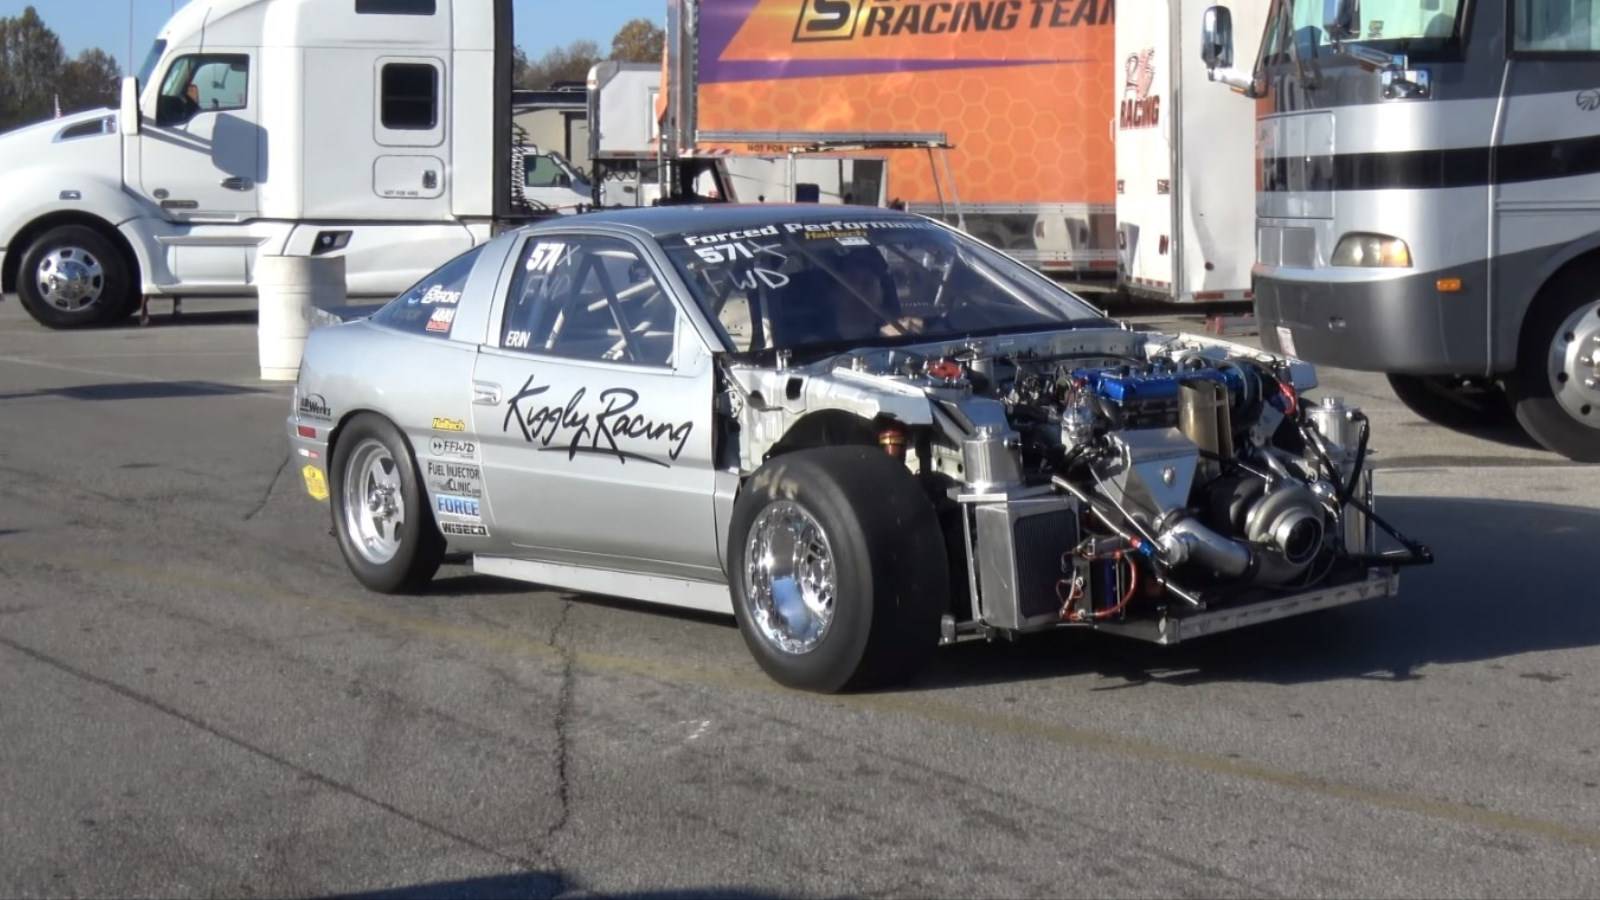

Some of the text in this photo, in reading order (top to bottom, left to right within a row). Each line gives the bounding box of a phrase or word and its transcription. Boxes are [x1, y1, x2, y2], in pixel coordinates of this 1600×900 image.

[862, 0, 1020, 37] RACING
[1120, 95, 1160, 129] RACING
[684, 225, 779, 247] Forced
[525, 242, 566, 273] 571
[505, 331, 531, 349] ERIN
[503, 374, 694, 464] Kiggly Racing
[427, 462, 480, 480] FUEL INJECTOR
[437, 496, 480, 516] FORCE
